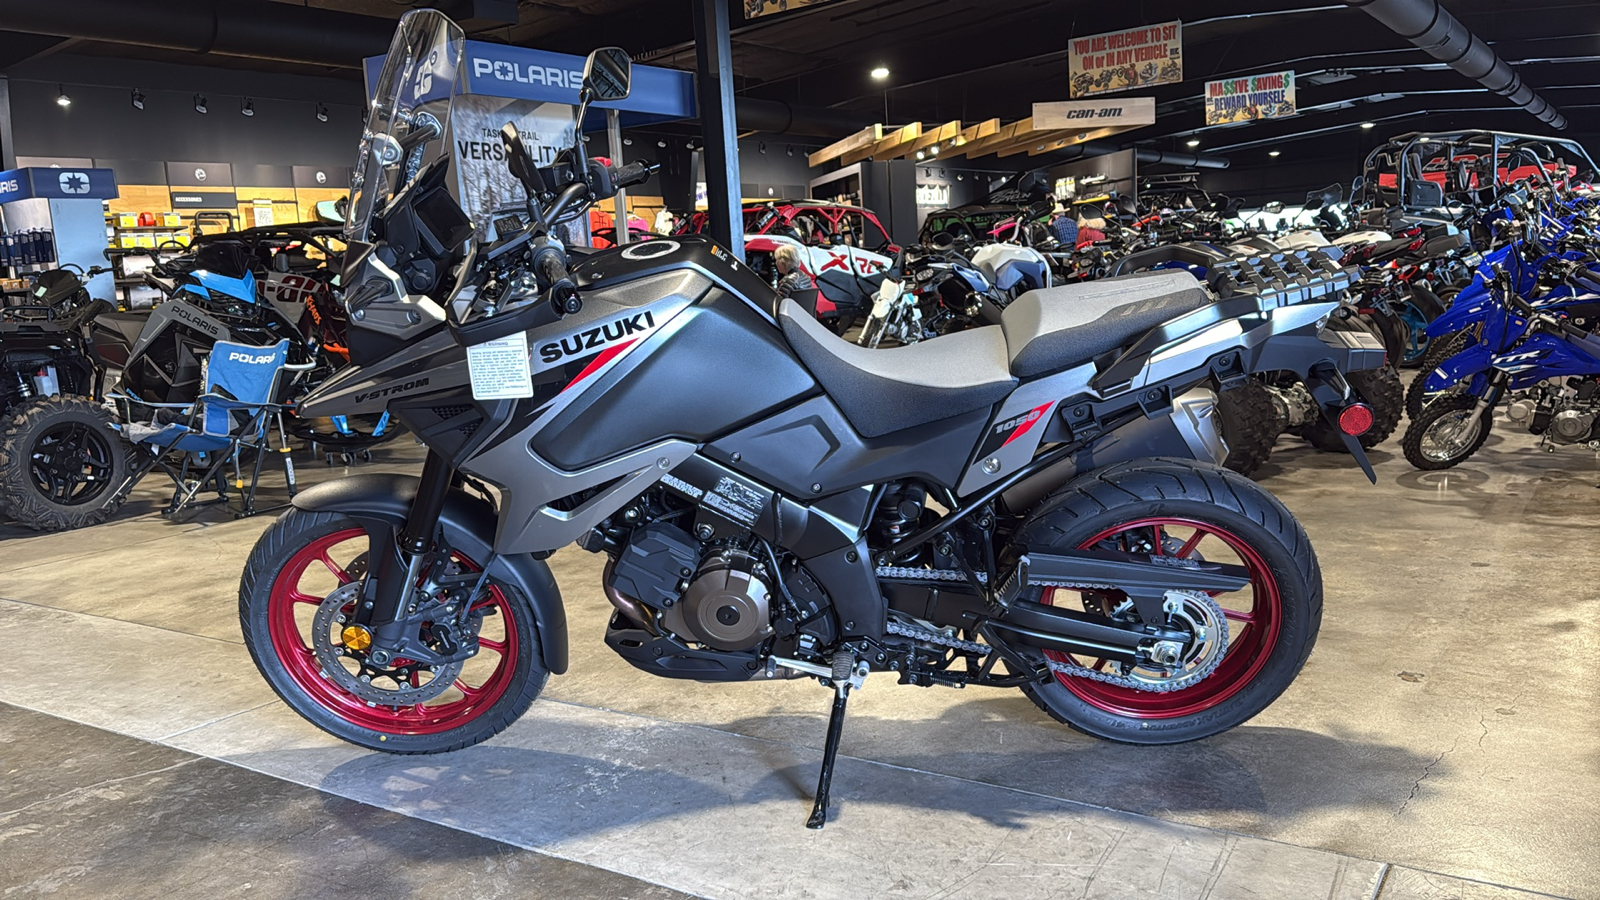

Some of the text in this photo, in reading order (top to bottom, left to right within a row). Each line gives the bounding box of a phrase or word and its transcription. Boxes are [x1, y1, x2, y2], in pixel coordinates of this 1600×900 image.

[1074, 24, 1177, 55] YOU ARE WELCOME TO SIT
[1083, 56, 1094, 71] ON
[1106, 52, 1115, 67] IN
[1117, 49, 1133, 65] ANY
[1135, 43, 1168, 62] VEHICLE
[473, 57, 583, 89] POLARIS
[1067, 107, 1122, 119] can-am
[1214, 94, 1246, 112] REWARD
[1248, 90, 1285, 106] YOURSELF
[0, 180, 18, 193] RIS
[171, 305, 218, 335] POLARIS
[540, 311, 655, 363] SUZUKI
[355, 377, 429, 403] V-STROM
[996, 410, 1041, 434] 1050
